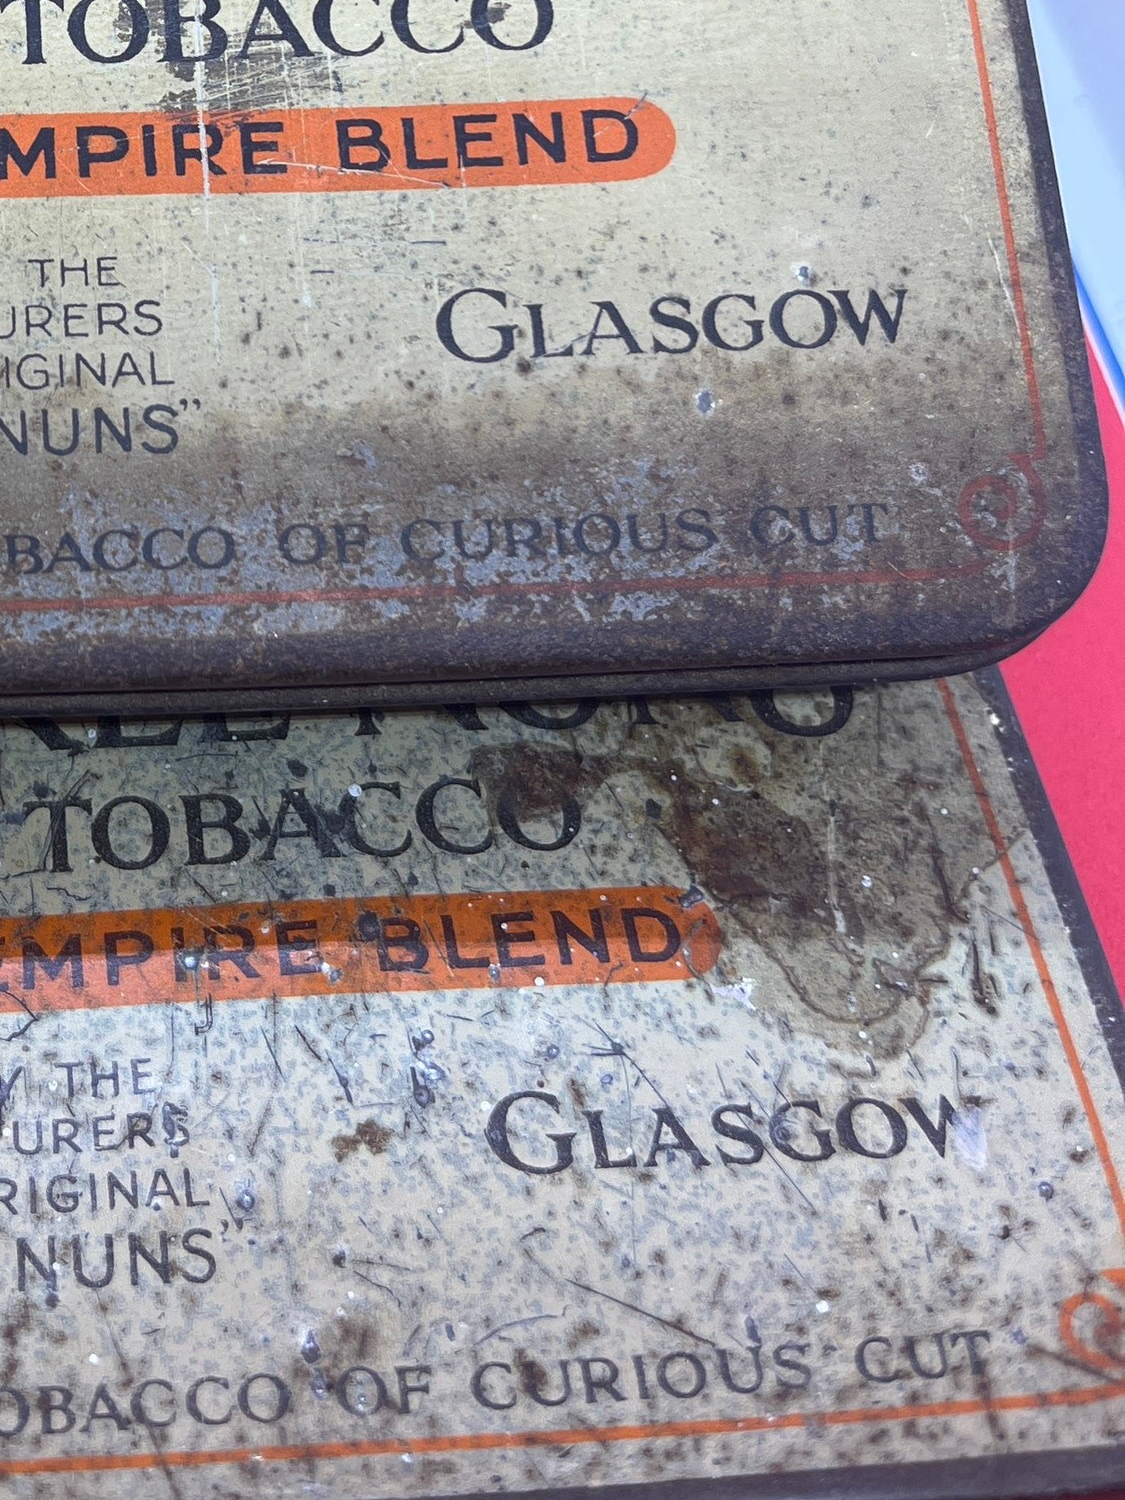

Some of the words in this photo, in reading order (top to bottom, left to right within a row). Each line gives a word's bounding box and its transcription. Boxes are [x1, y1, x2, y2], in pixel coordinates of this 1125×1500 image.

[335, 108, 639, 173] BLEND
[27, 255, 127, 289] THE
[435, 287, 908, 364] GLASGOW
[278, 522, 370, 567] OF
[398, 505, 718, 564] CURIOUS
[748, 501, 896, 549] CUT
[23, 777, 581, 872] TOBACCO
[375, 903, 680, 974] BLEND
[52, 1057, 156, 1098] THE
[335, 1363, 432, 1417] OF
[471, 1338, 813, 1412] CURIOUS
[854, 1328, 991, 1384] CUT
